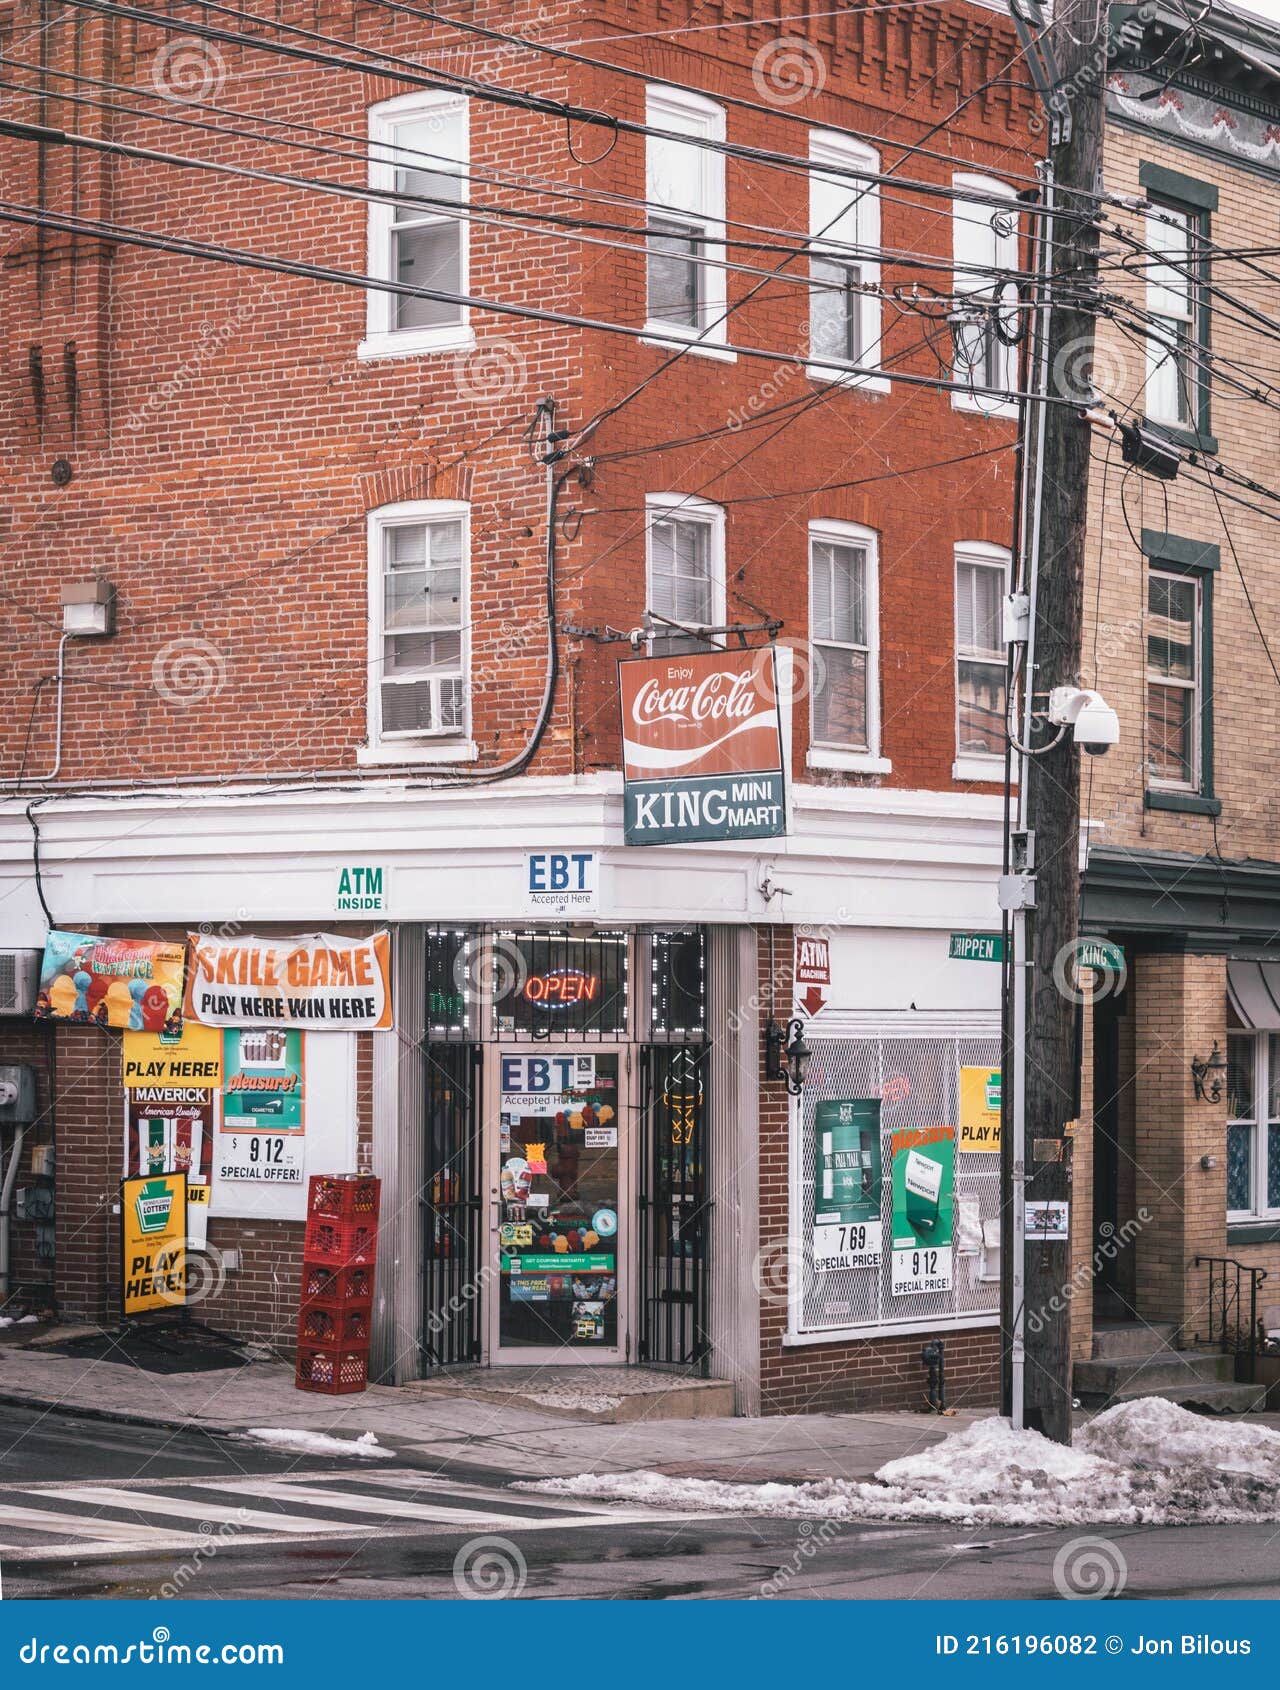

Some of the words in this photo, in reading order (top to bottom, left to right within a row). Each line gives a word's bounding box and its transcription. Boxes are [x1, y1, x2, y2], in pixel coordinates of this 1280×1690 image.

[667, 667, 694, 681] Enjoy
[632, 669, 760, 726] Coca-Cola
[732, 781, 772, 802] MINI
[634, 789, 729, 830] KING
[728, 806, 781, 828] MART
[338, 867, 383, 895] ATM
[529, 854, 593, 890] EBT
[338, 898, 382, 910] INSIDE
[531, 894, 569, 905] Accepted
[571, 894, 591, 904] Here
[800, 941, 828, 968] ATM
[1082, 944, 1108, 965] KING
[133, 960, 154, 979] ICE
[198, 946, 280, 986] SKILL
[287, 947, 375, 987] GAME
[800, 969, 828, 980] MACHINE
[525, 976, 597, 1000] OPEN
[201, 993, 237, 1016] PLAY
[240, 997, 285, 1018] HERE
[287, 997, 326, 1018] WIN
[329, 997, 376, 1018] HERE
[126, 1061, 166, 1077] PLAY
[170, 1061, 219, 1077] HERE!
[502, 1058, 574, 1092] EBT
[227, 1071, 298, 1094] pleasure!
[136, 1088, 206, 1102] MAVERICK
[504, 1095, 550, 1107] Accepted
[140, 1105, 174, 1116] American
[175, 1105, 202, 1119] Quality
[961, 1126, 991, 1141] PLAY
[232, 1137, 238, 1149] $
[250, 1137, 284, 1163] 9.12
[220, 1166, 262, 1179] SPECIAL
[264, 1167, 300, 1180] OFFER!
[143, 1203, 170, 1214] LOTTERY
[838, 1225, 867, 1252] 7.69
[131, 1250, 180, 1276] PLAY
[815, 1256, 850, 1271] SPECIAL
[852, 1253, 881, 1267] PRICE!
[126, 1271, 183, 1299] HERE!
[894, 1280, 924, 1294] SPECIAL
[925, 1277, 950, 1290] PRICE!
